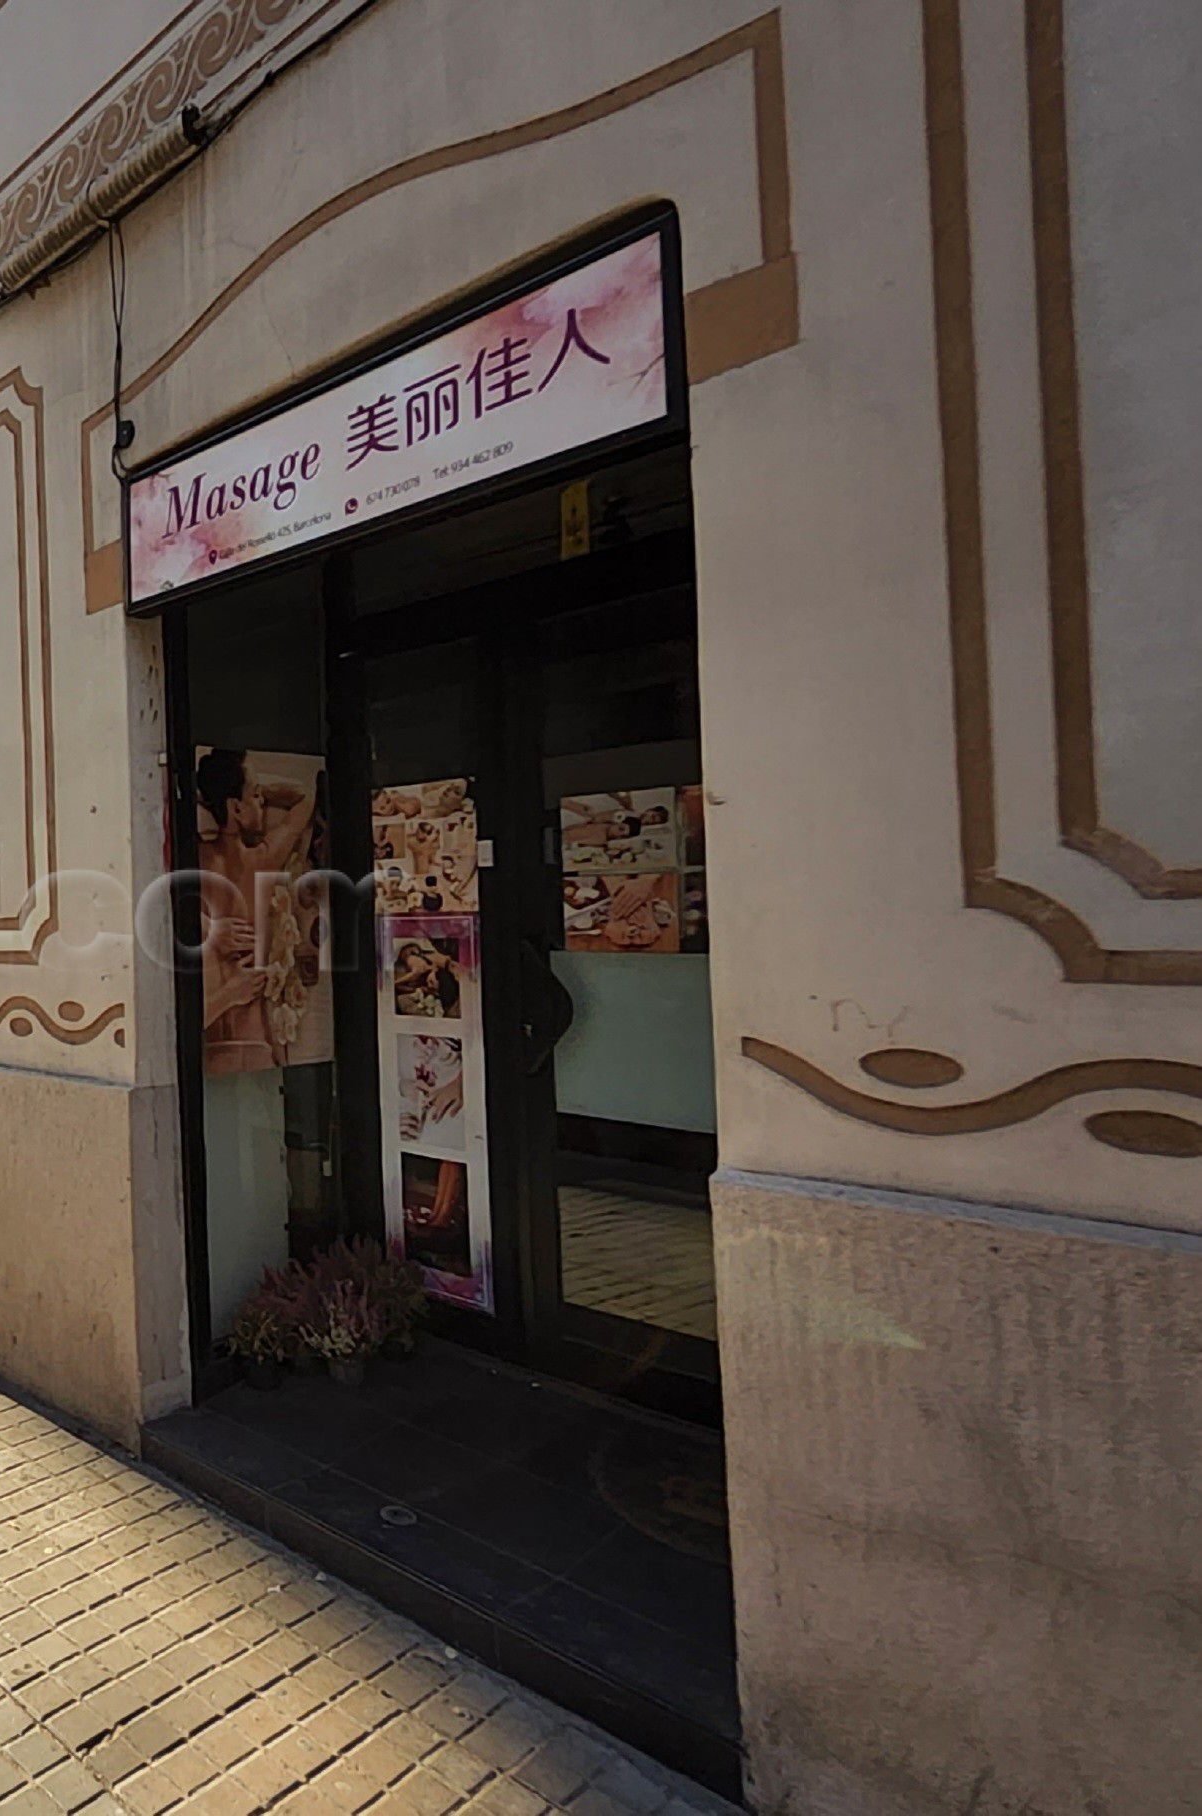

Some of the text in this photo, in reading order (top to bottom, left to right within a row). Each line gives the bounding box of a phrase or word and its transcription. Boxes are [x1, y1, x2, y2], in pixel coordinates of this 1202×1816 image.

[345, 307, 611, 472] 美丽佳人
[161, 443, 322, 539] Masage
